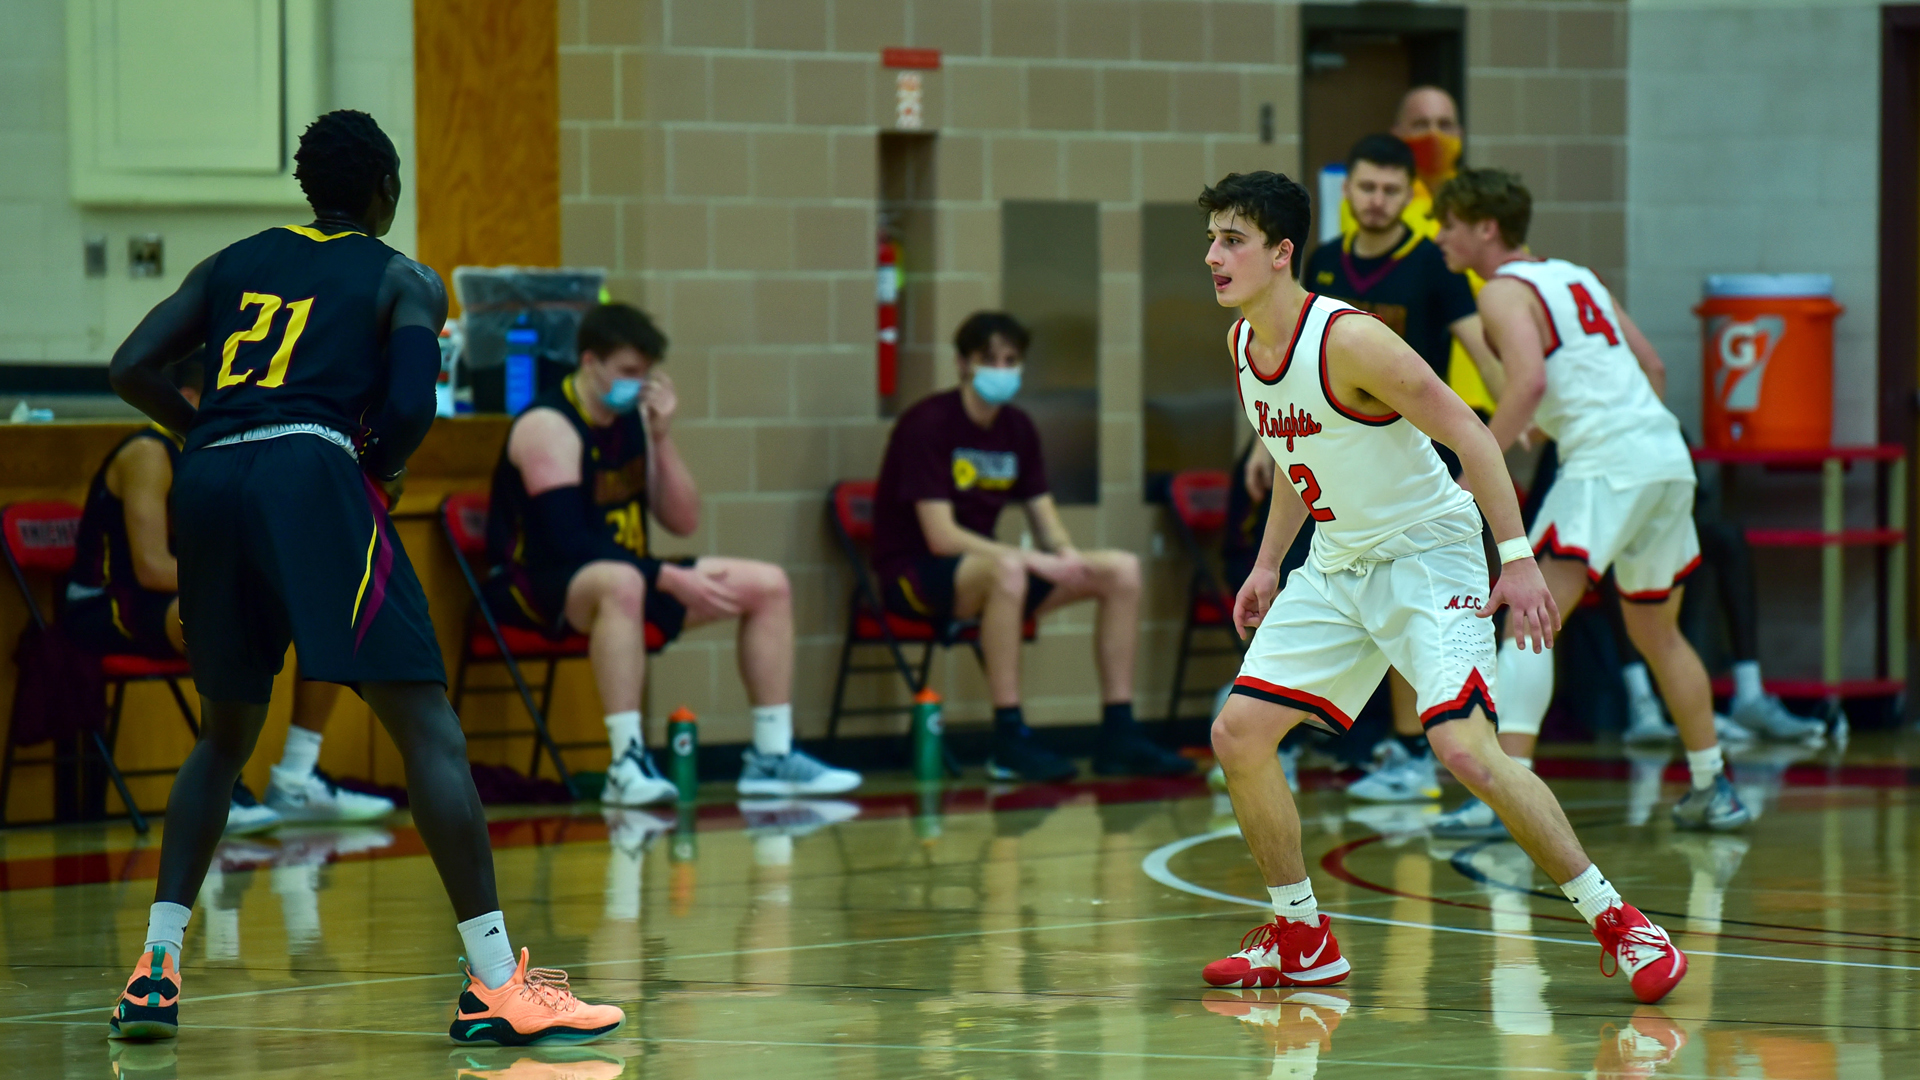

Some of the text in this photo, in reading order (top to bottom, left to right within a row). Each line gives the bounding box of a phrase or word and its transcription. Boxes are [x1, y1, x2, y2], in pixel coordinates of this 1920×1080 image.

[216, 291, 316, 390] 21
[1567, 282, 1619, 346] 4
[1254, 400, 1322, 452] Knights
[1288, 463, 1336, 522] 2
